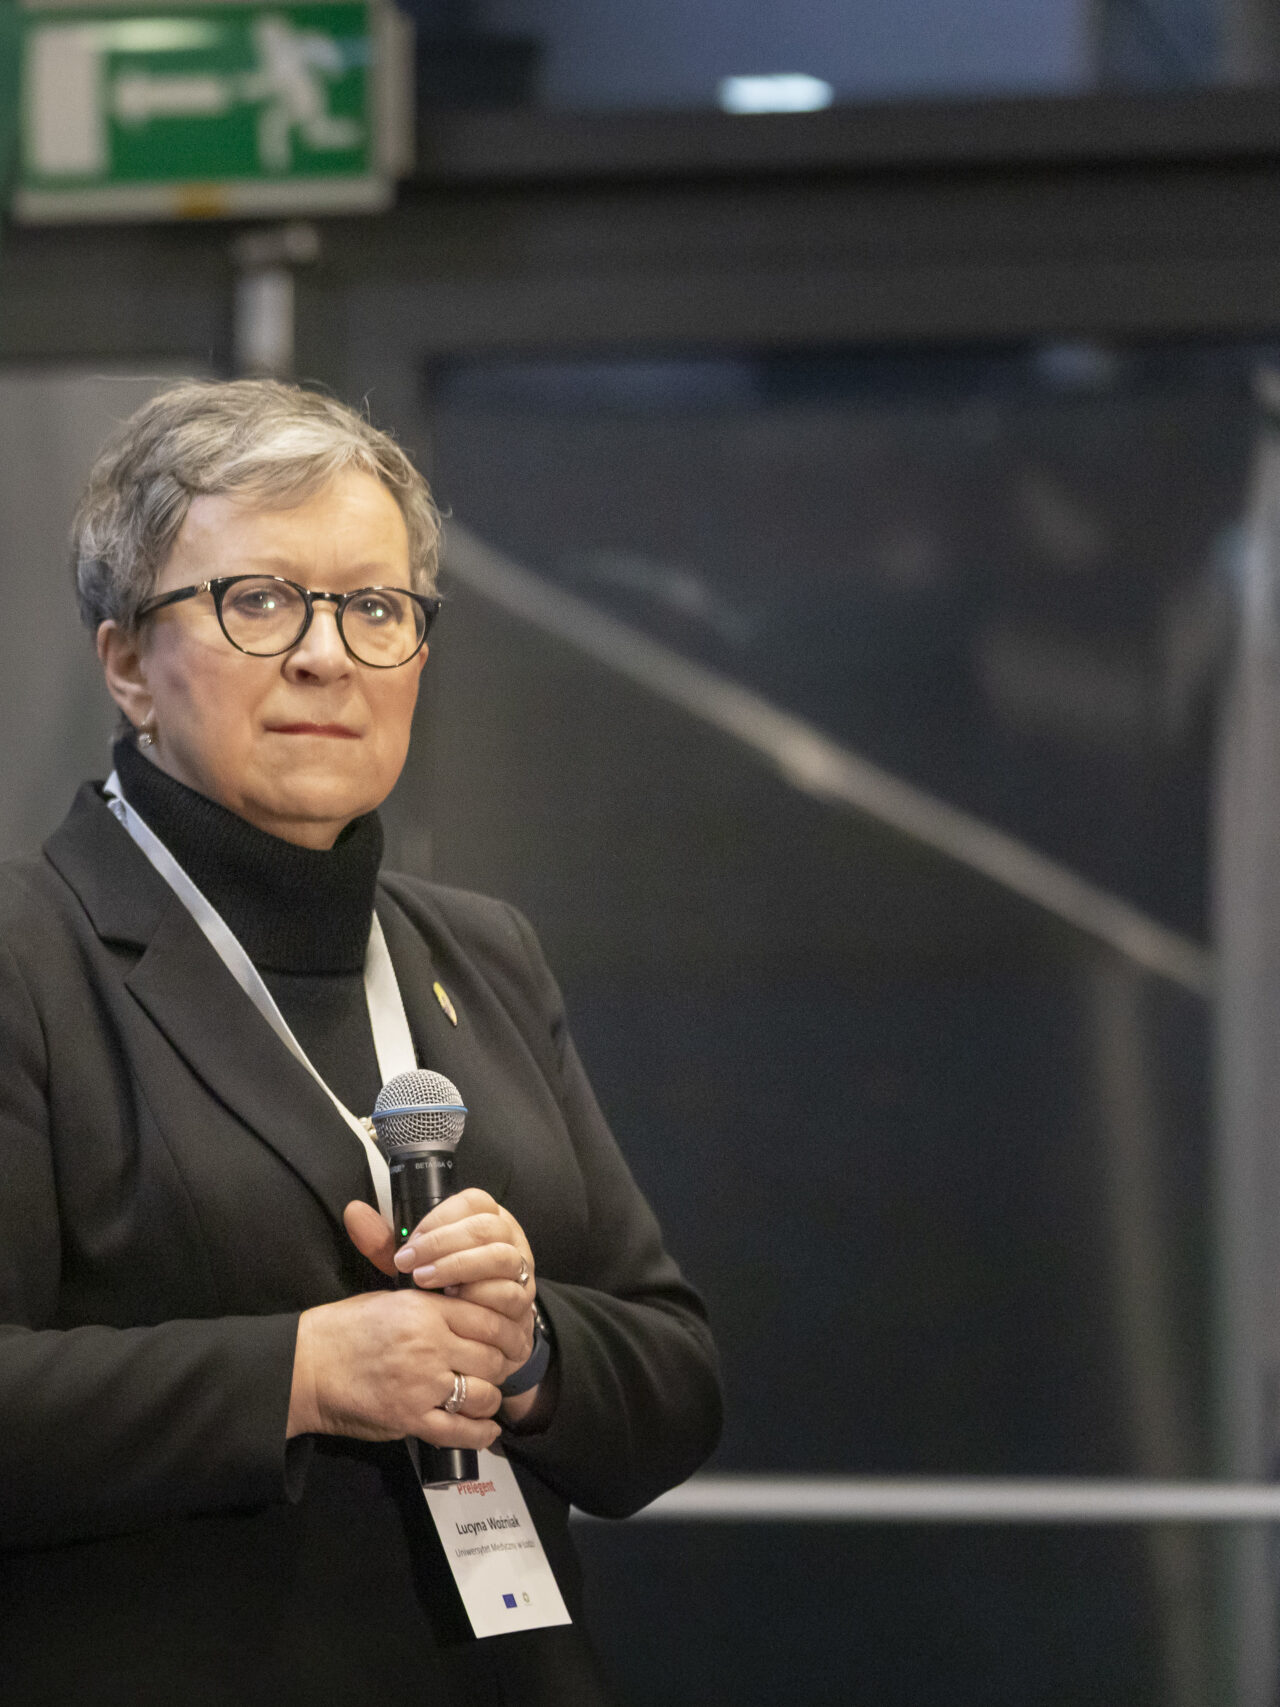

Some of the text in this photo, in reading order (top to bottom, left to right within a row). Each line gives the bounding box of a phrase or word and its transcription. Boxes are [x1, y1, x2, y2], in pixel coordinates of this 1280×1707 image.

[457, 1480, 496, 1496] Prelegent
[455, 1514, 521, 1536] Lucyna Woźniak
[455, 1544, 491, 1558] Uniwersytet
